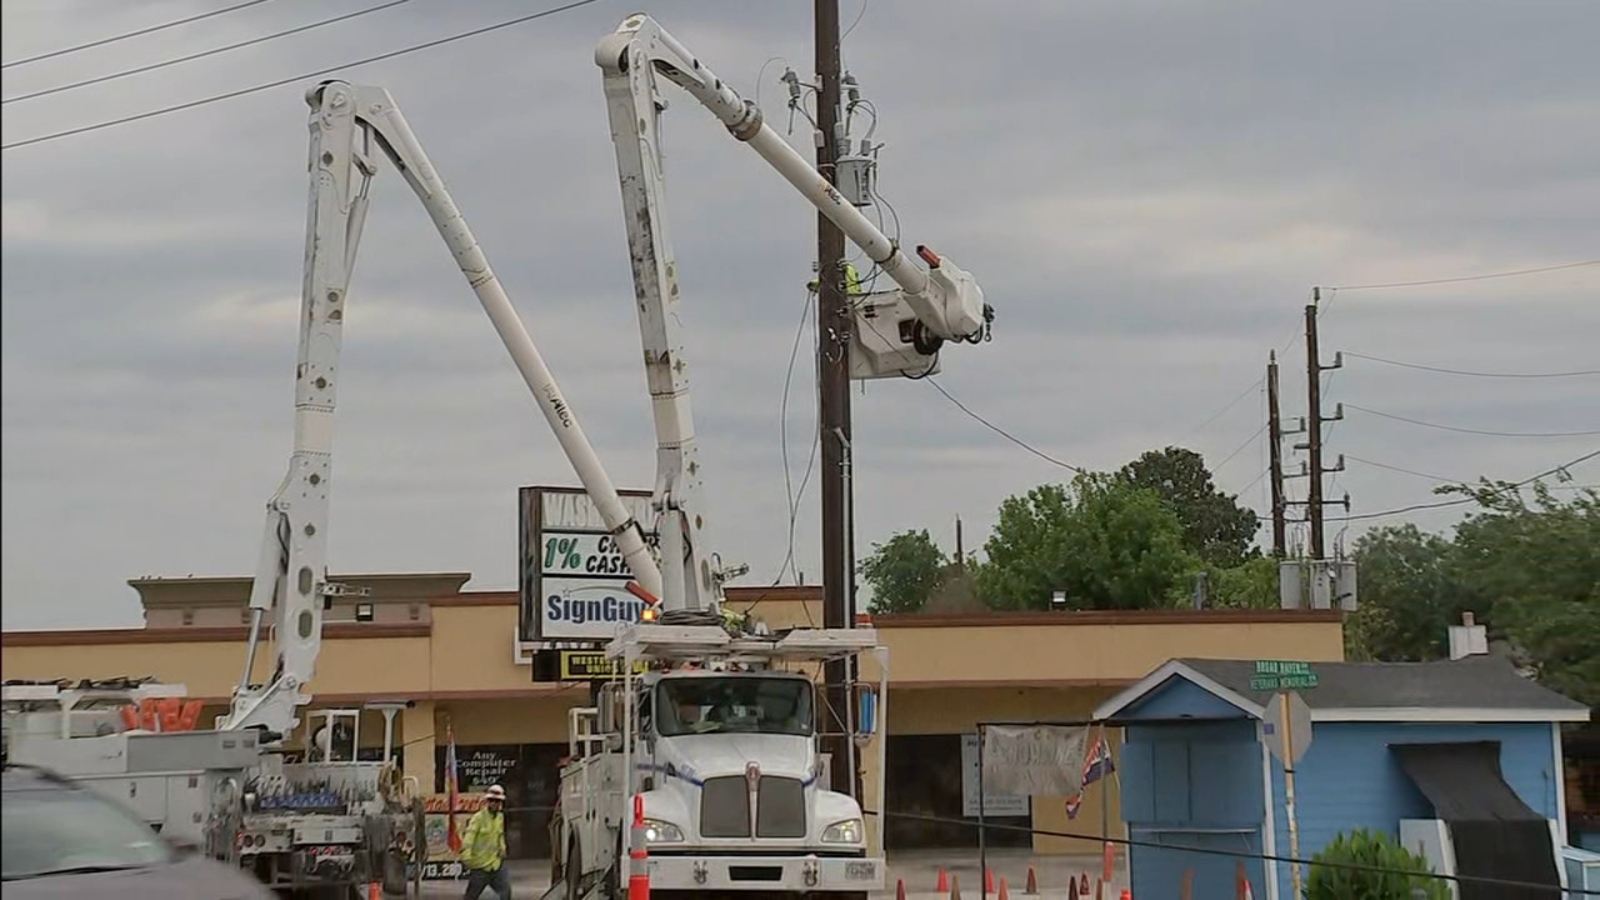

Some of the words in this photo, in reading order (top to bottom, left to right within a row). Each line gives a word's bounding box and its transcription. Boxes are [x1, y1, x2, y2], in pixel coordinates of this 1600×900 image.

[544, 537, 581, 569] 1%
[473, 751, 497, 760] Any
[456, 759, 516, 769] Computer
[465, 767, 507, 779] Repair
